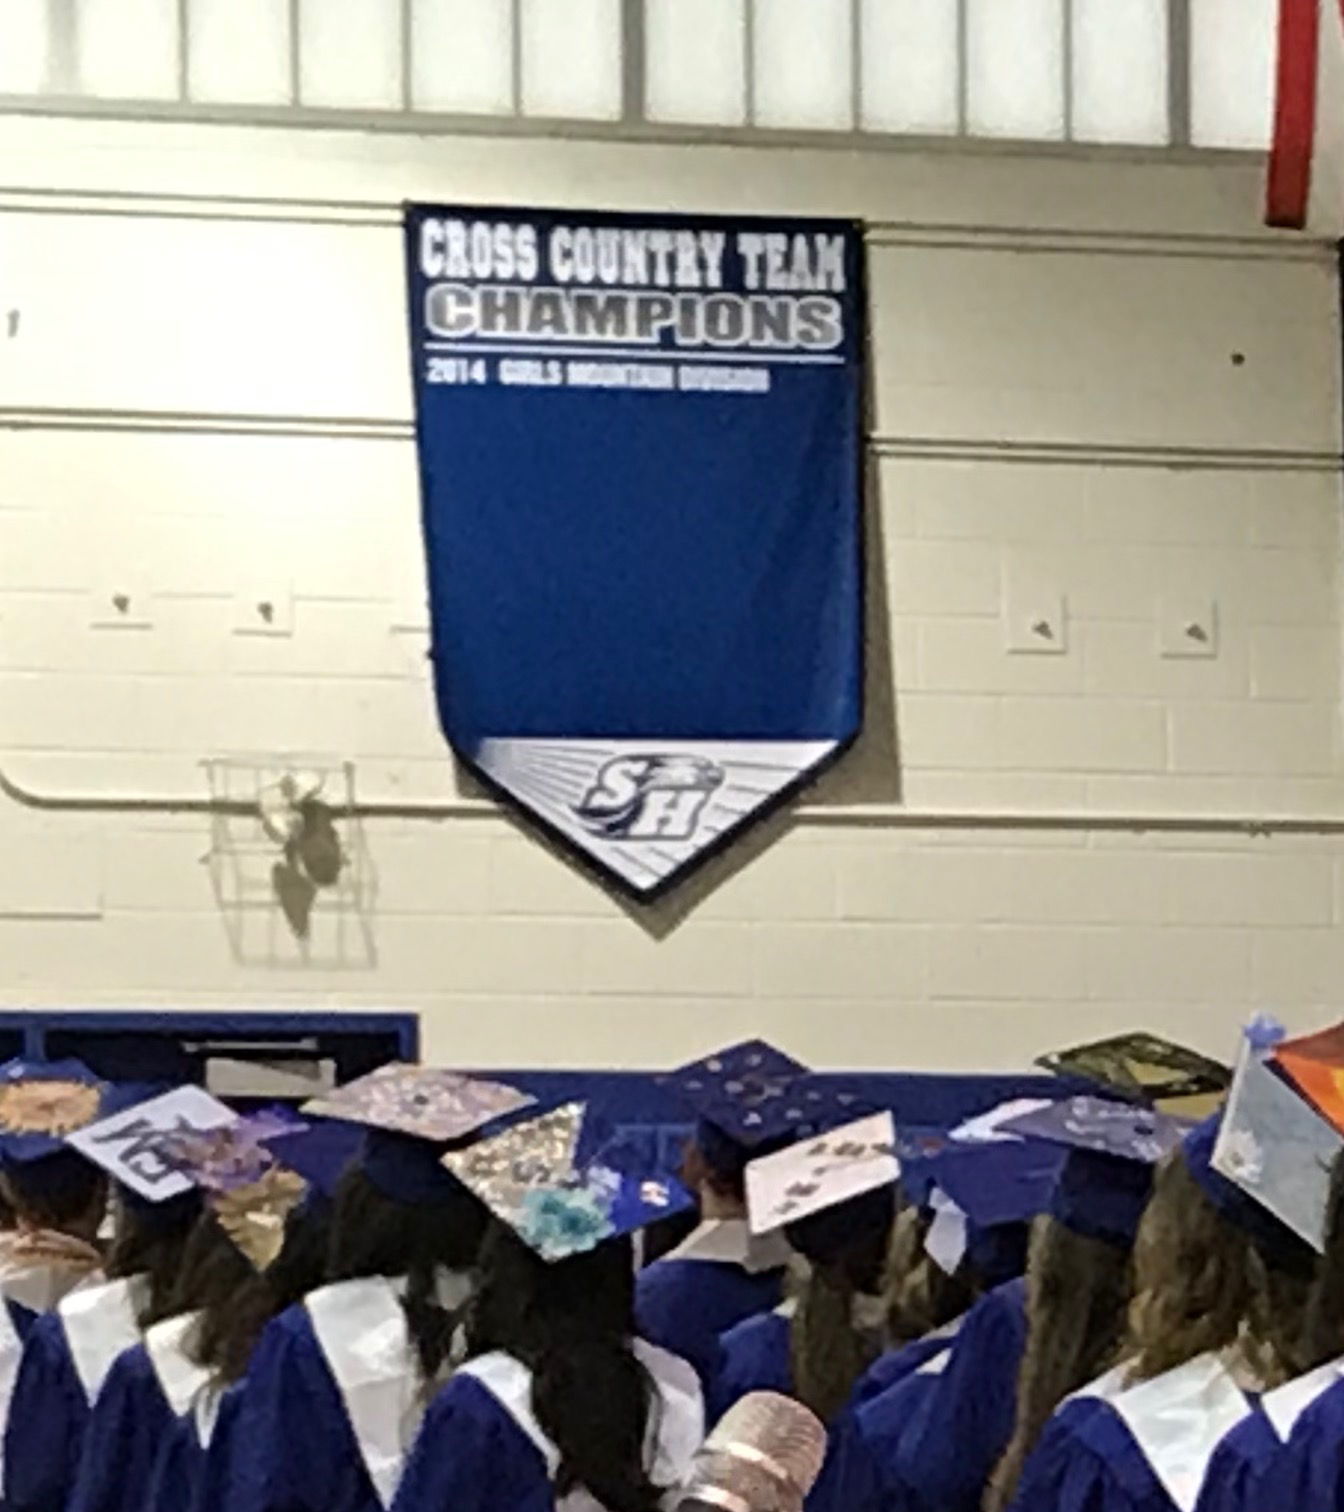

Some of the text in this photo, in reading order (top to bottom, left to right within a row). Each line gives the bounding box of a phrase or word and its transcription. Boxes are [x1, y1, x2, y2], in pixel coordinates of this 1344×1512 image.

[420, 219, 846, 292] CROSS COUNTRY TEAM
[425, 283, 844, 349] CHAMPIONS
